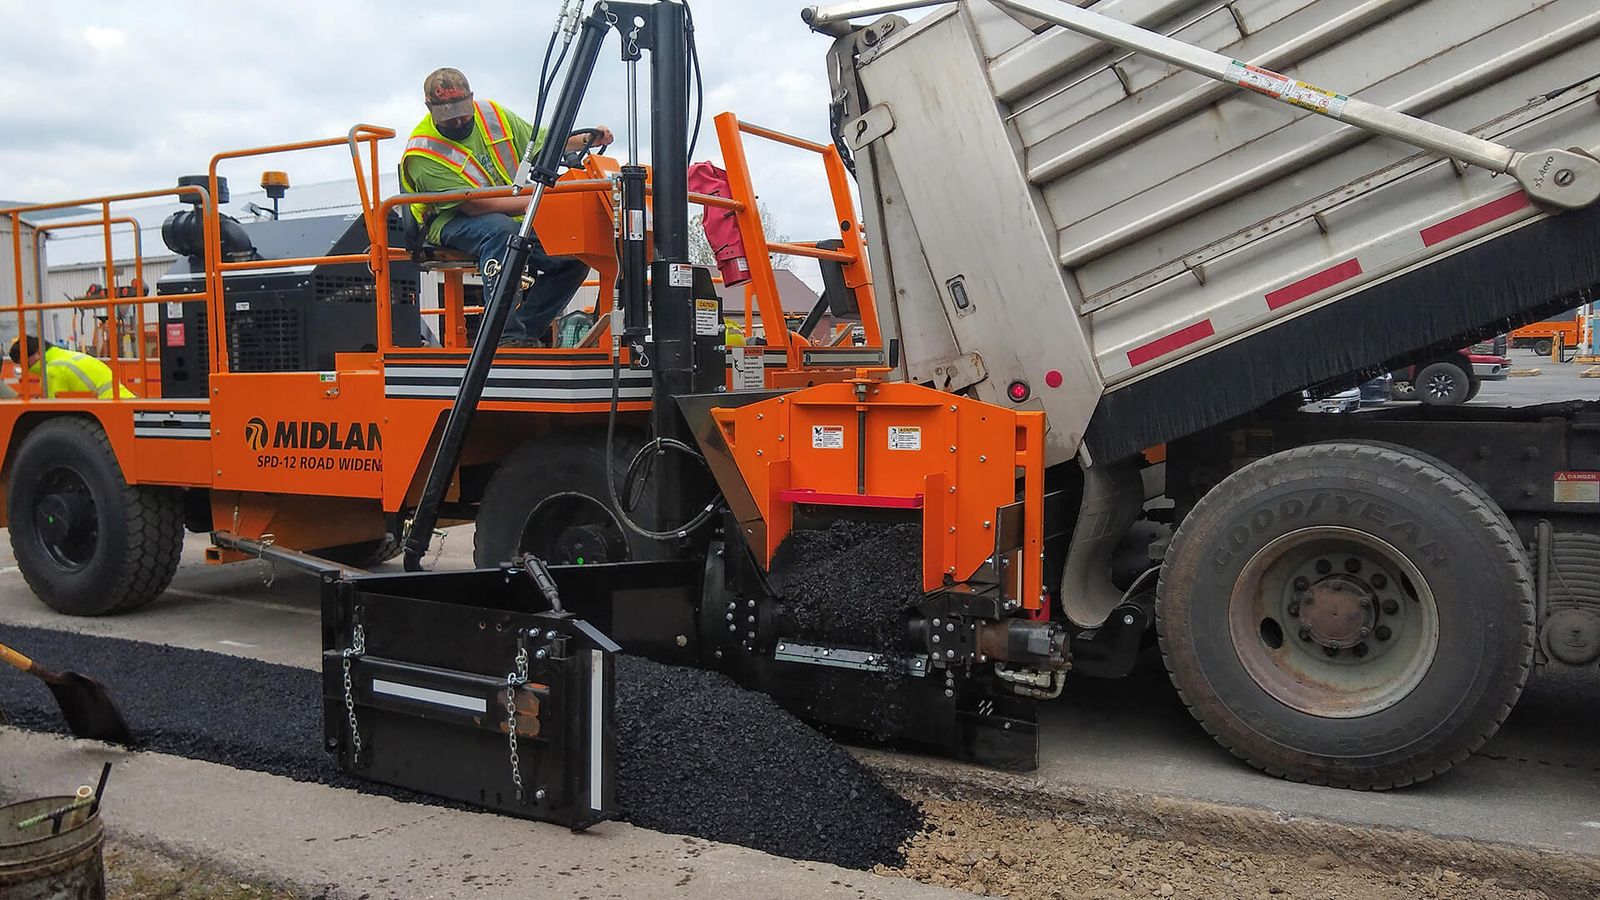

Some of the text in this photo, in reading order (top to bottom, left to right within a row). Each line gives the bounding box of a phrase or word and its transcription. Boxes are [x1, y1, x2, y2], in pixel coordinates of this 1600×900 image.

[272, 421, 383, 451] MIDLAN
[257, 455, 297, 469] SPD-12
[299, 456, 335, 470] ROAD
[1213, 492, 1448, 568] GOODYEAR
